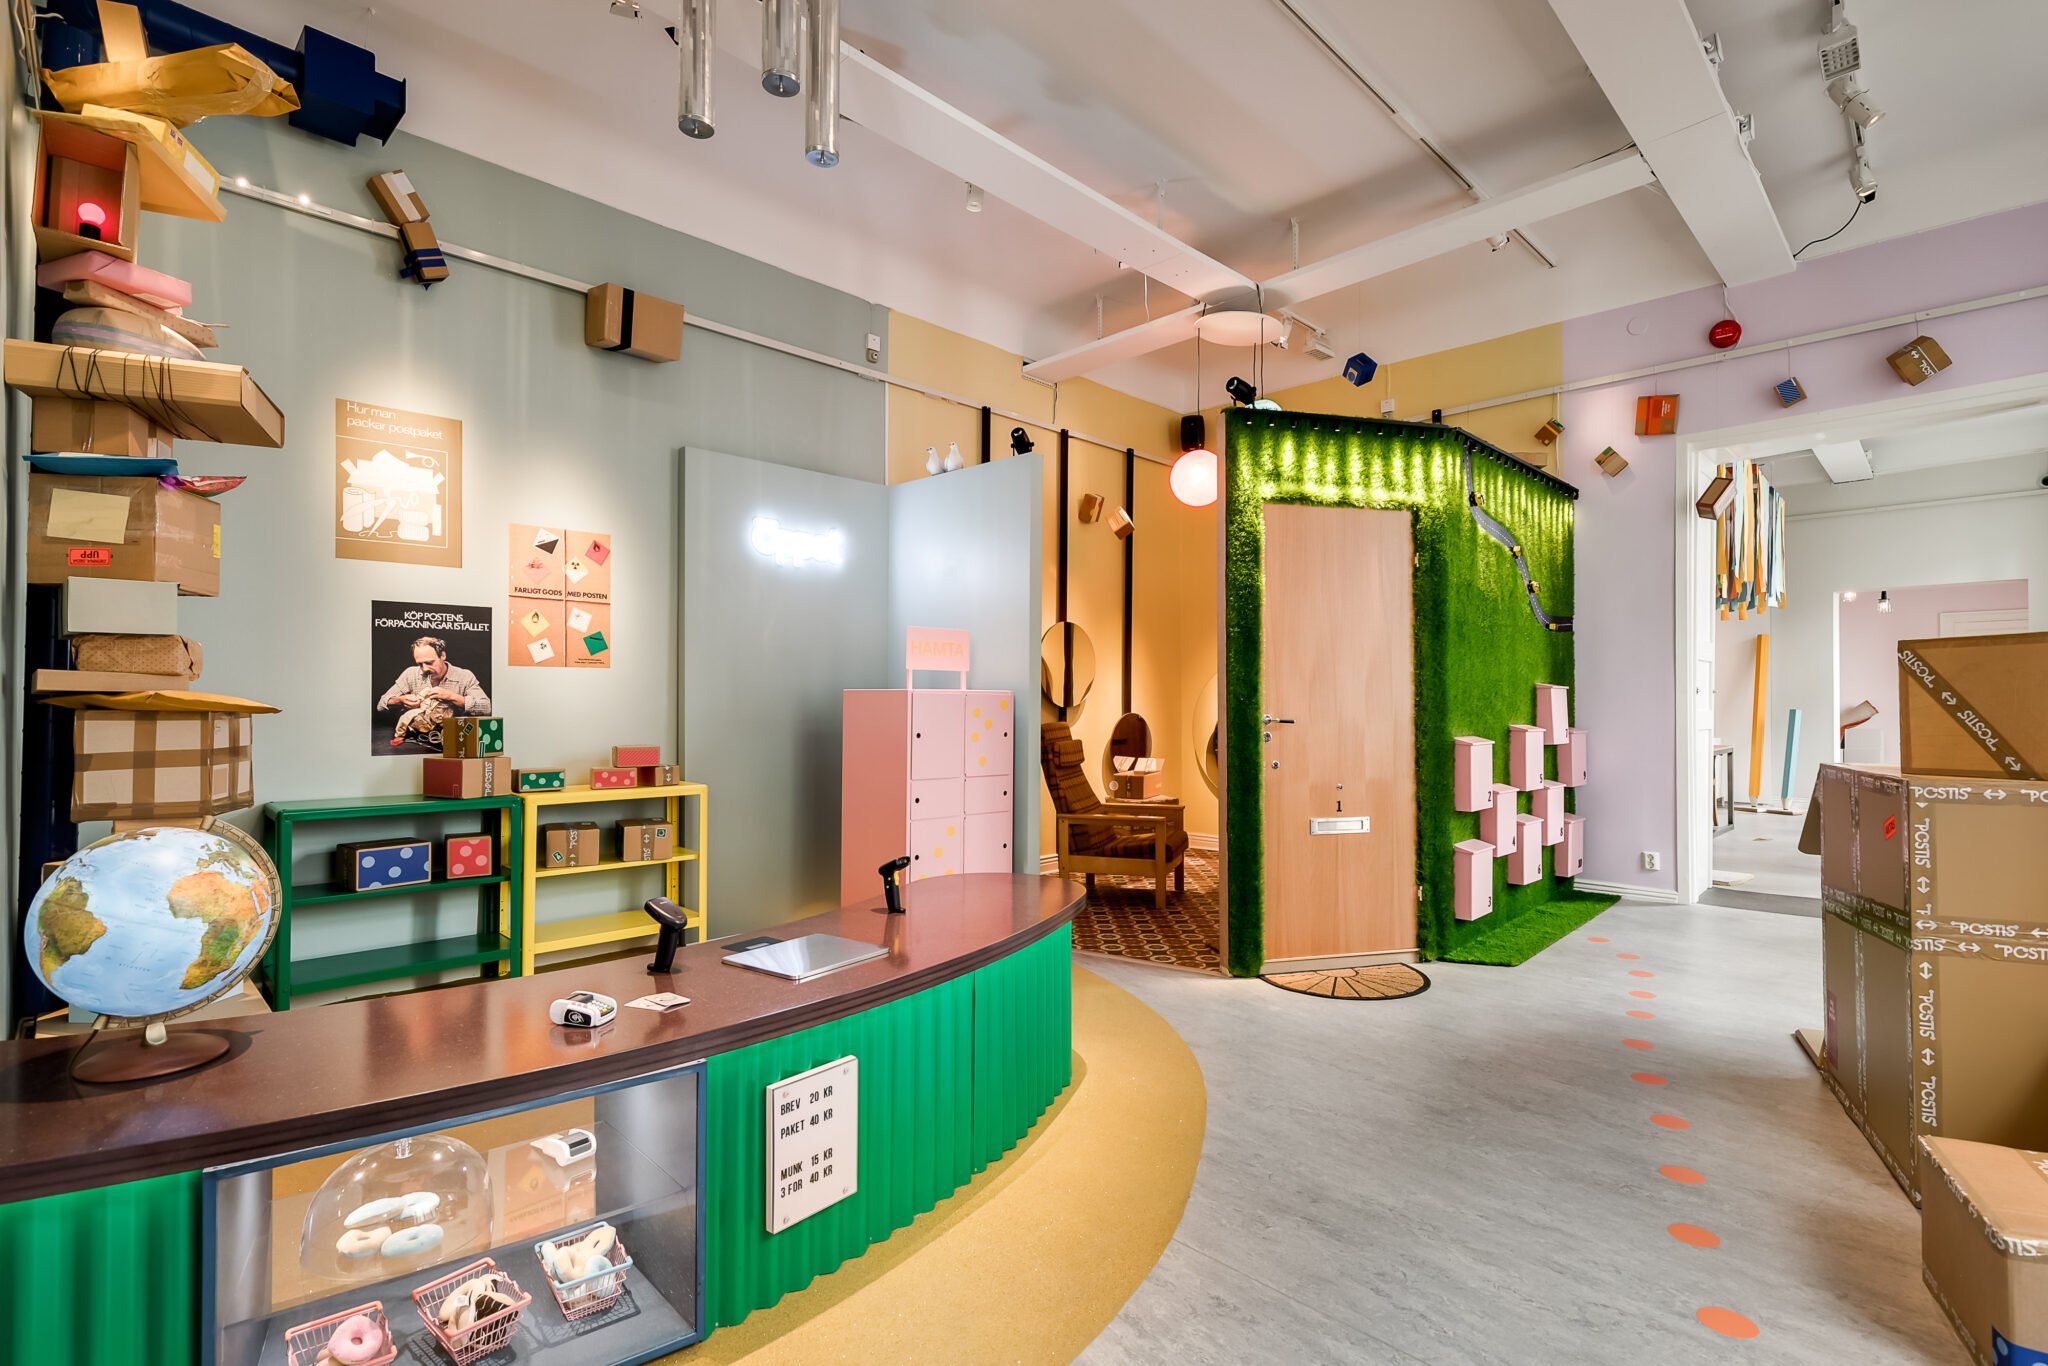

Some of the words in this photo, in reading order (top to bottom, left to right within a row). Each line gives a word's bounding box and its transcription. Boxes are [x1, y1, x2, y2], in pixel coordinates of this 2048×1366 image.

[346, 401, 369, 415] Hur
[370, 409, 396, 420] man
[346, 417, 385, 431] packar
[388, 423, 444, 440] postpaket
[80, 550, 99, 559] UPP
[514, 586, 541, 595] FARLIGT
[542, 589, 563, 597] GODS
[582, 592, 608, 600] POSTEN
[375, 618, 453, 630] FÖRPACKNINGAR
[404, 611, 423, 620] KÖP
[424, 612, 463, 622] POSTENS
[1336, 800, 1342, 812] 1
[780, 1098, 801, 1116] BREV
[809, 1091, 820, 1104] 20
[823, 1085, 833, 1099] KR
[780, 1119, 805, 1139] PAKET
[809, 1114, 820, 1127] 40
[823, 1108, 833, 1121] KR
[780, 1161, 803, 1181] MUNK
[811, 1153, 820, 1167] 15
[823, 1147, 833, 1161] KR
[780, 1187, 787, 1198] 3
[809, 1171, 820, 1184] 40
[823, 1164, 833, 1178] KR
